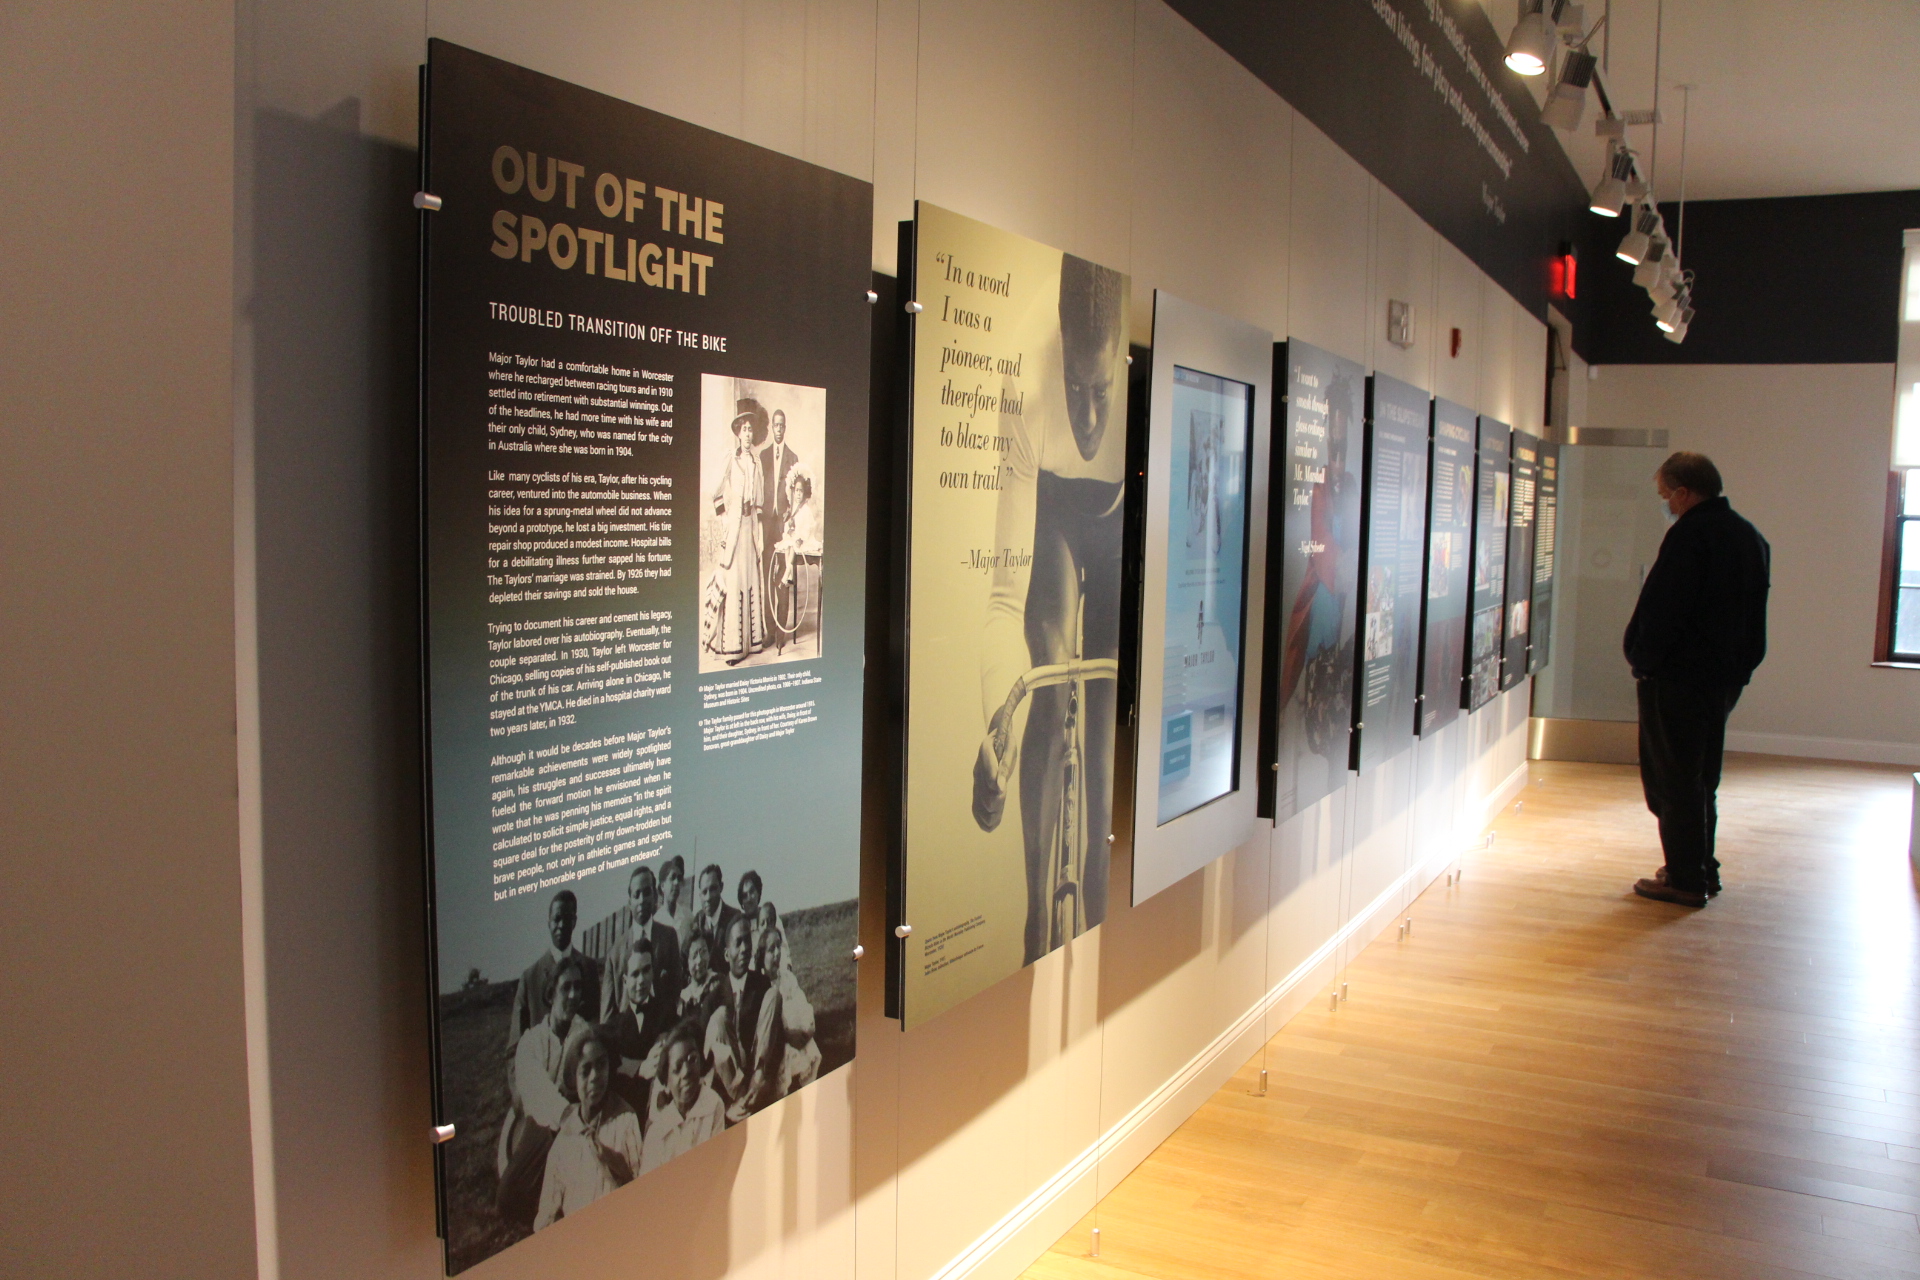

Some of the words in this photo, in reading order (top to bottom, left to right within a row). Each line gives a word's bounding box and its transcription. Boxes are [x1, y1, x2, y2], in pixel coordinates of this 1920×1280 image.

[492, 145, 584, 209] OUT
[595, 173, 646, 223] OF
[655, 186, 723, 244] THE
[491, 210, 713, 296] SPOTLIGHT
[936, 252, 962, 284] “In
[966, 271, 974, 287] a
[979, 273, 1010, 297] word
[489, 302, 562, 328] TROUBLED
[569, 314, 645, 340] TRANSITION
[650, 327, 672, 344] OFF
[677, 331, 698, 348] THE
[703, 335, 726, 352] BIKE
[941, 295, 950, 322] I
[954, 308, 980, 329] was
[984, 316, 991, 332] a
[489, 352, 512, 365] Major
[515, 355, 538, 367] Taylor
[541, 358, 555, 368] had
[559, 362, 563, 370] a
[566, 362, 608, 374] comfortable
[611, 366, 630, 377] home
[633, 368, 639, 378] in
[642, 370, 674, 381] Worcester
[939, 339, 992, 376] pioneer,
[997, 353, 1022, 377] and
[489, 371, 512, 381] where
[515, 372, 524, 382] he
[526, 374, 563, 388] recharged
[565, 377, 595, 390] between
[597, 382, 617, 394] racing
[619, 384, 636, 394] tours
[638, 385, 650, 395] and
[651, 386, 657, 395] in
[659, 388, 673, 397] 1910
[941, 379, 997, 418] therefore
[1000, 389, 1024, 415] had
[489, 388, 516, 399] settled
[518, 390, 532, 400] into
[534, 392, 572, 404] retirement
[574, 395, 588, 405] with
[591, 397, 628, 409] substantial
[630, 401, 660, 413] winnings.
[662, 403, 673, 412] Out
[489, 405, 497, 414] of
[499, 405, 512, 416] the
[514, 406, 552, 420] headlines,
[554, 410, 564, 420] he
[566, 411, 579, 420] had
[581, 414, 599, 422] more
[601, 413, 616, 423] time
[618, 414, 632, 425] with
[634, 416, 644, 426] his
[645, 417, 659, 426] wife
[661, 418, 672, 427] and
[488, 423, 506, 433] their
[509, 424, 525, 436] only
[528, 425, 548, 436] child,
[550, 426, 578, 439] Sydney,
[580, 429, 595, 438] who
[597, 431, 611, 439] was
[613, 430, 636, 440] named
[638, 432, 647, 441] for
[649, 433, 659, 442] the
[661, 433, 672, 445] city
[489, 439, 496, 450] in
[498, 440, 532, 452] Australia
[534, 443, 557, 452] where
[559, 443, 572, 453] she
[574, 446, 588, 454] was
[590, 445, 606, 455] born
[608, 445, 614, 455] in
[616, 447, 633, 456] 1904.
[941, 426, 953, 447] to
[957, 422, 989, 450] blaze
[993, 435, 1013, 461] my
[489, 470, 504, 481] Like
[509, 473, 530, 483] many
[532, 472, 560, 483] cyclists
[562, 472, 570, 482] of
[571, 473, 582, 483] his
[584, 475, 596, 484] era,
[598, 474, 620, 485] Taylor,
[621, 474, 636, 484] after
[638, 475, 648, 484] his
[650, 476, 672, 487] cycling
[940, 471, 969, 488] own
[972, 466, 1013, 491] trail.”
[1003, 549, 1032, 573] Taylor
[488, 623, 512, 635] Trying
[514, 622, 522, 631] to
[524, 618, 561, 631] document
[563, 617, 574, 627] his
[576, 617, 597, 626] career
[599, 614, 612, 624] and
[614, 613, 638, 623] cement
[640, 611, 649, 621] his
[651, 610, 672, 621] legacy,
[491, 751, 526, 766] Although
[529, 750, 533, 759] it
[537, 747, 558, 758] would
[561, 744, 570, 753] be
[572, 739, 601, 752] decades
[604, 735, 625, 746] before
[627, 732, 645, 743] Major
